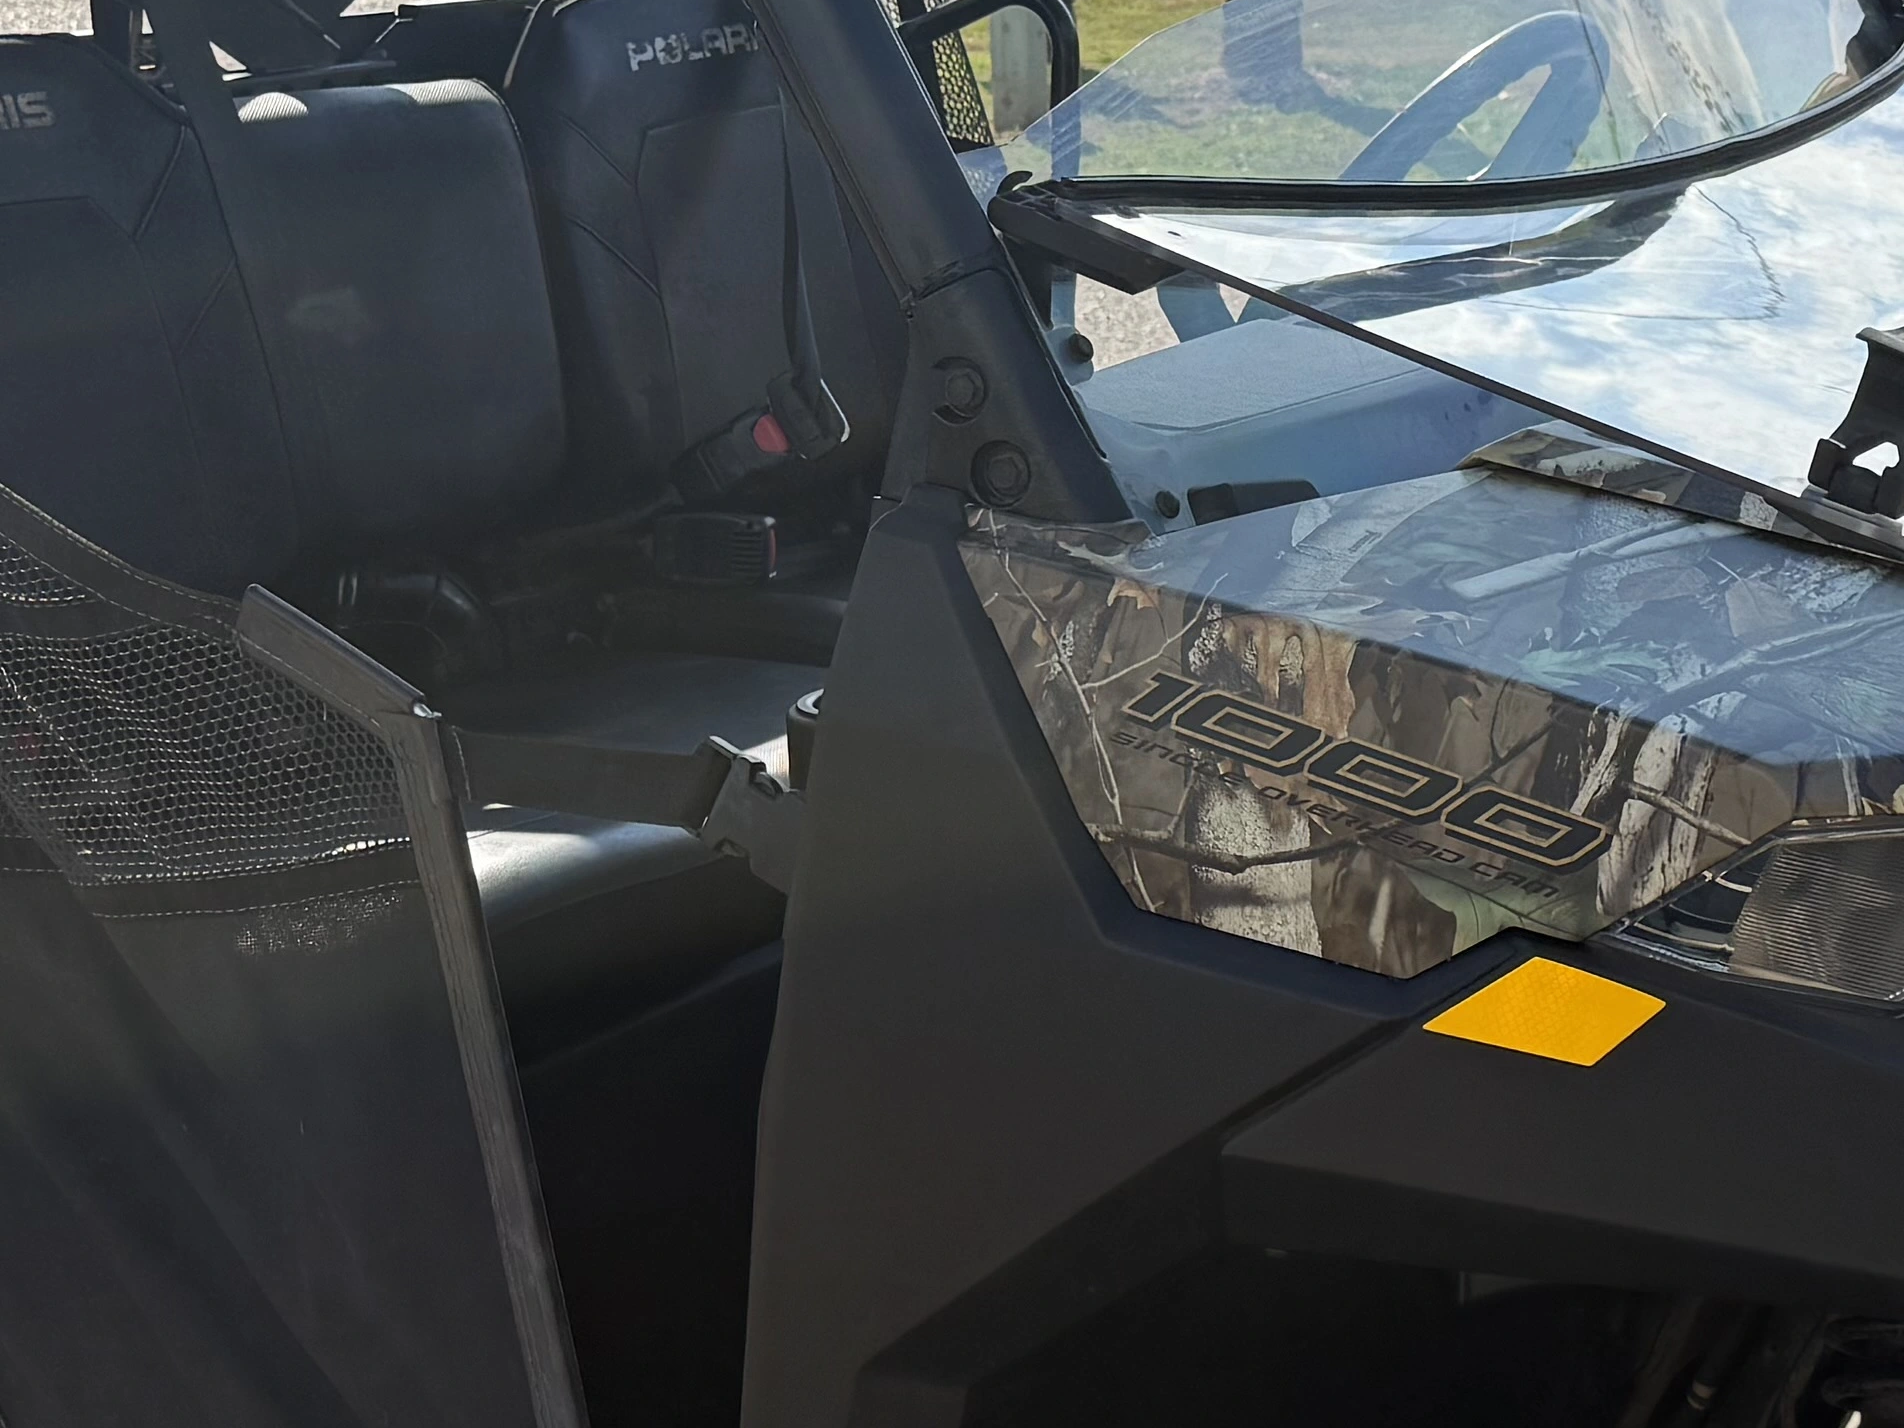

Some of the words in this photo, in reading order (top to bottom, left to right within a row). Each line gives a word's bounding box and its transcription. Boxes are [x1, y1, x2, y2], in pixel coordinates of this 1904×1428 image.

[626, 23, 759, 72] POLARI
[1122, 670, 1613, 868] 1000
[1469, 862, 1559, 898] CAM
